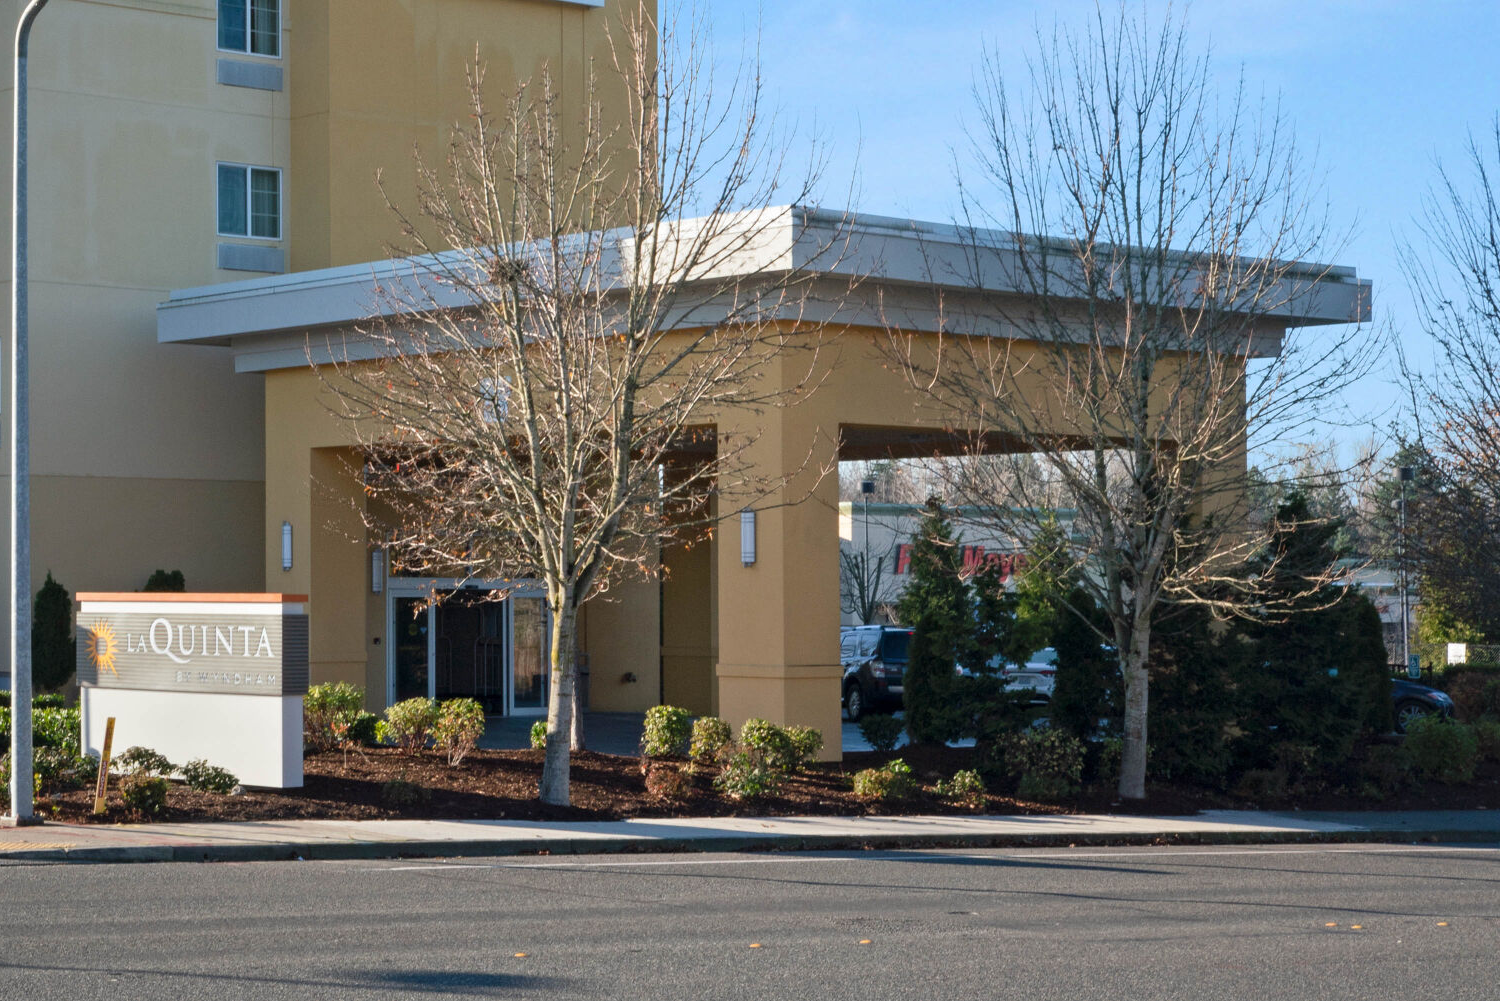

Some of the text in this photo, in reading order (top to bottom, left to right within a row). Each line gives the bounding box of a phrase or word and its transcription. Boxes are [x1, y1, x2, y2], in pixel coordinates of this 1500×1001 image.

[127, 618, 276, 664] LA QUINTA
[176, 671, 276, 685] BY WYNDHAM
